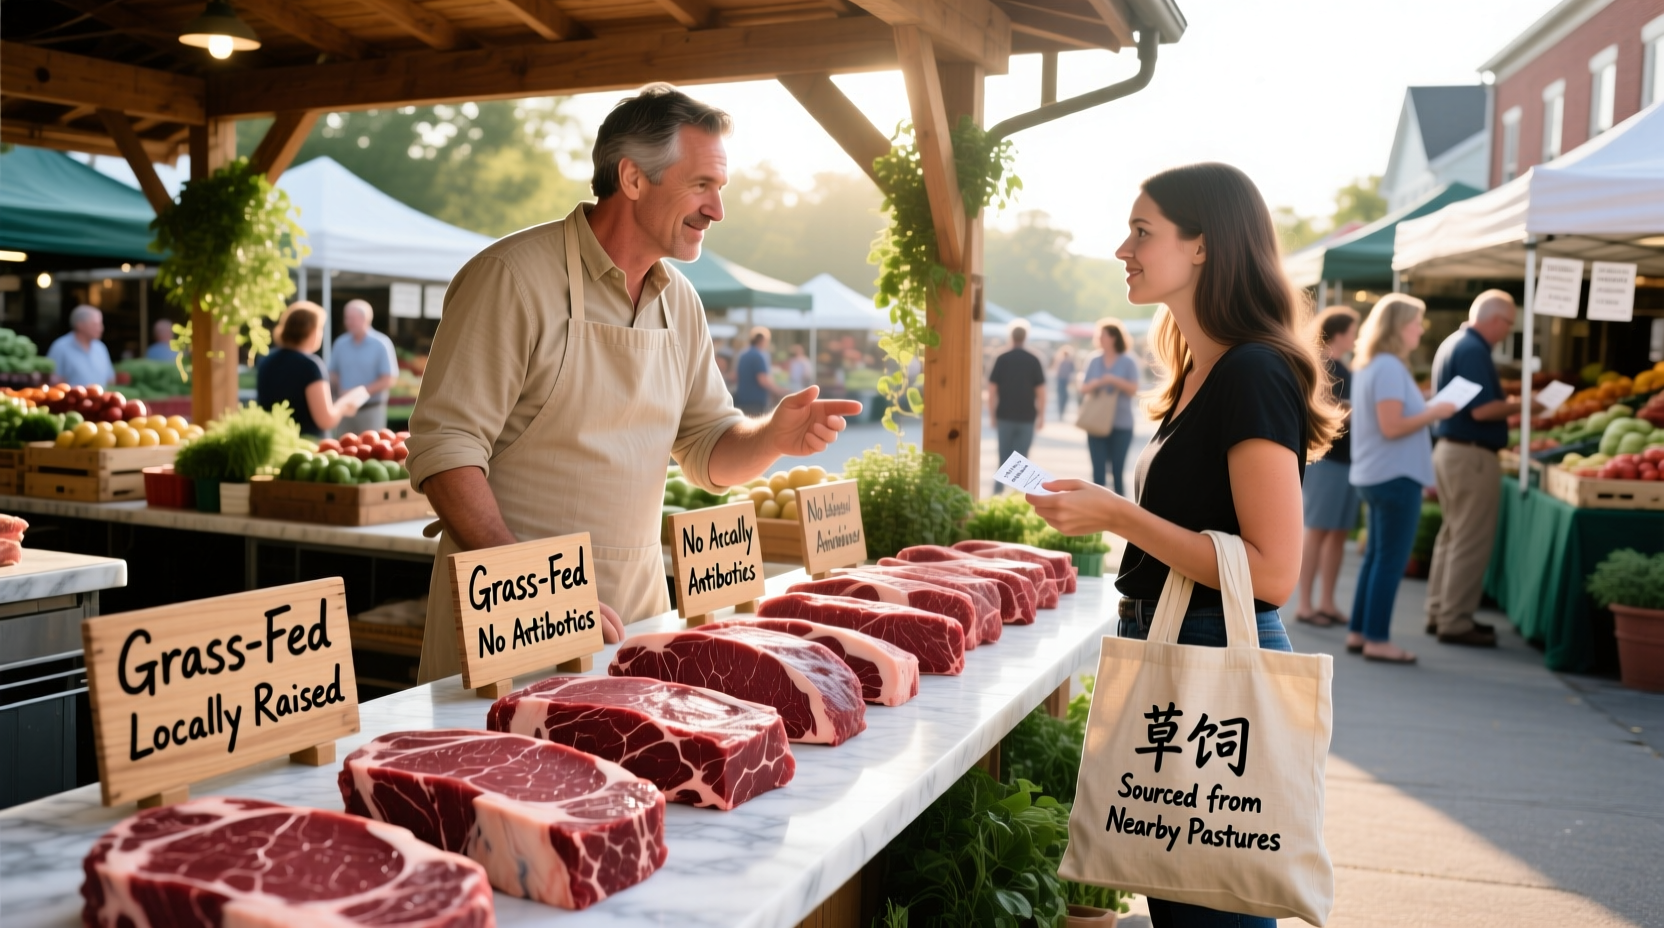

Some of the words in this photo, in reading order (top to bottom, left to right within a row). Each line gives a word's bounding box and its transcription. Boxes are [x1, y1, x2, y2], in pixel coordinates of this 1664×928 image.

[682, 524, 704, 558] No
[469, 545, 588, 613] Grass-Fed
[118, 597, 332, 696] Grass-Fed
[478, 623, 506, 659] No
[129, 693, 242, 761] Locally
[254, 663, 345, 726] Raised
[1134, 702, 1250, 777] 草饲
[1117, 772, 1199, 808] Sourced
[1206, 783, 1262, 813] from
[1105, 805, 1181, 852] Nearby
[1187, 817, 1281, 851] Pastures
